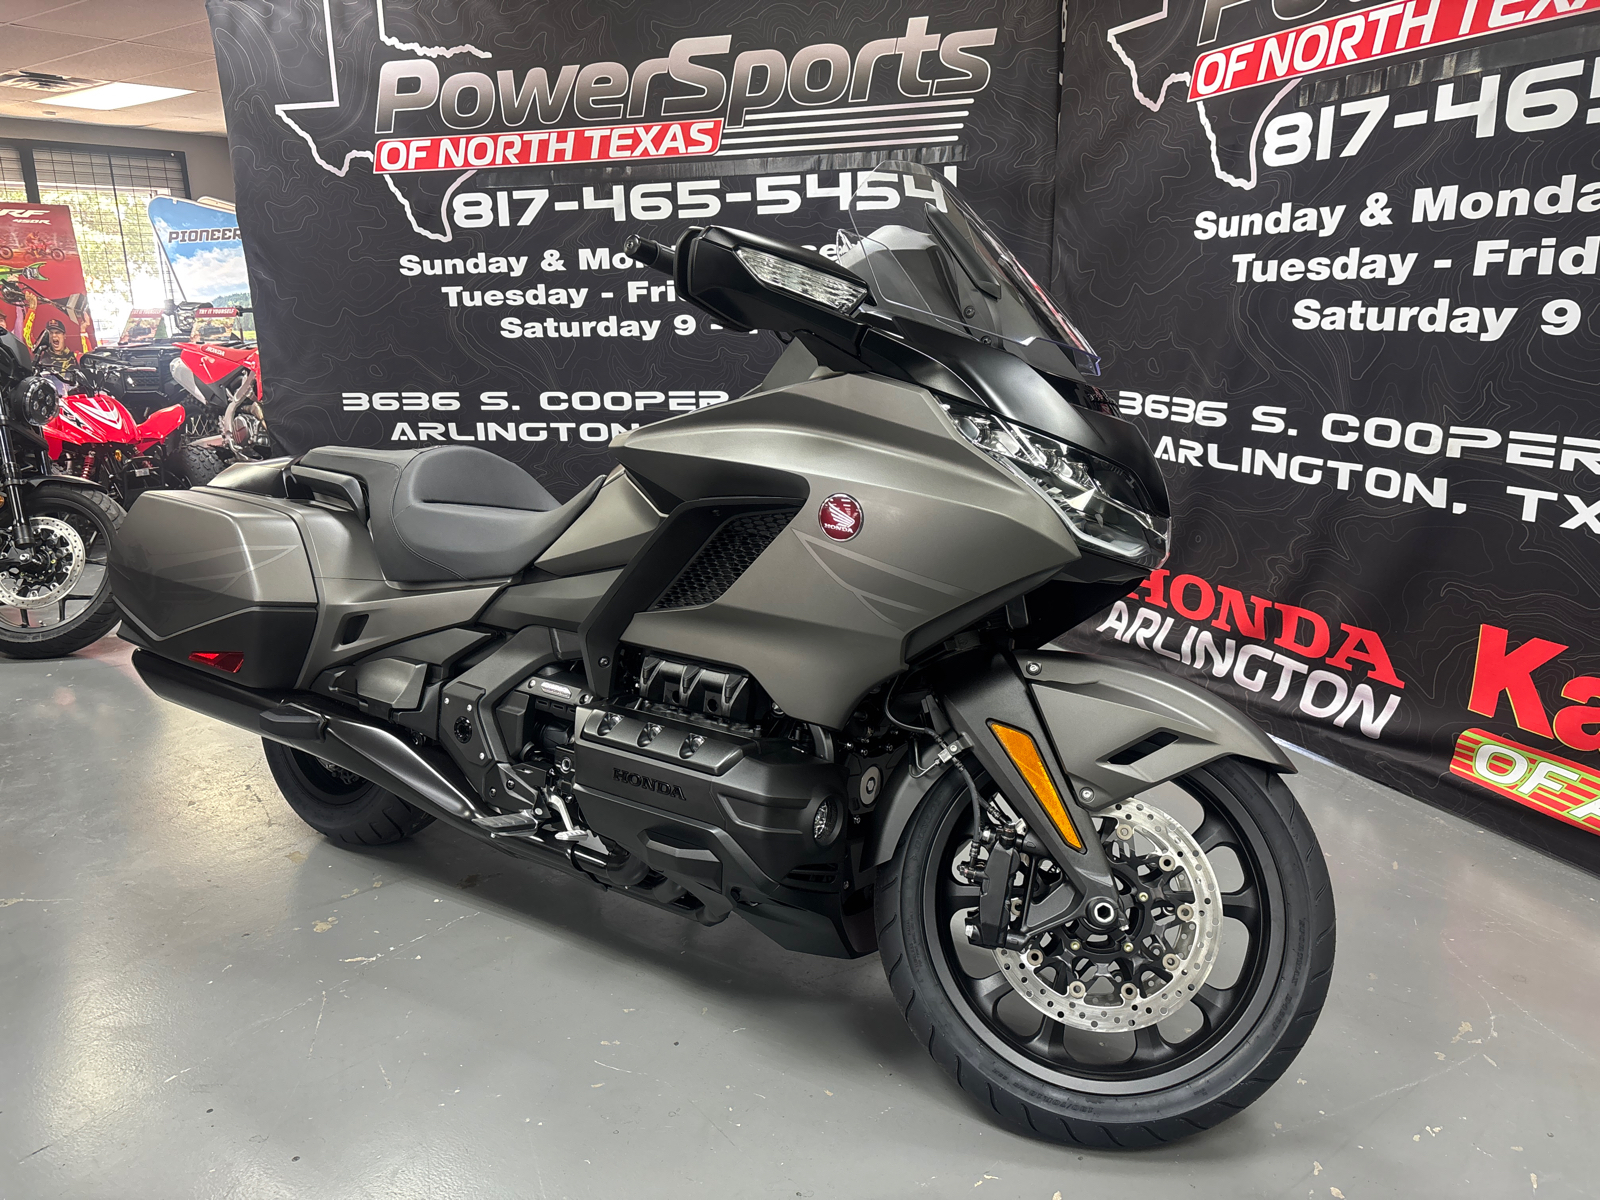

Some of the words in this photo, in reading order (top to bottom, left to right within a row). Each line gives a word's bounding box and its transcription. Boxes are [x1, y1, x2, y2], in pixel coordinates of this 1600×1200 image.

[1195, 43, 1256, 96] OF
[1257, 0, 1439, 81] NORTH
[374, 16, 998, 134] PowerSports
[1262, 57, 1600, 168] 817-46
[380, 140, 431, 170] OF
[437, 129, 584, 168] NORTH
[589, 120, 719, 159] TEXAS
[0, 209, 51, 218] RF
[452, 166, 958, 228] 817-465-5454
[1194, 203, 1346, 240] Sunday
[1359, 193, 1393, 227] &
[1411, 174, 1600, 223] Monda
[167, 227, 242, 244] PIONEER
[1232, 248, 1418, 286] Tuesday
[1473, 235, 1600, 276] Frid
[398, 251, 528, 277] Sunday
[541, 250, 567, 271] &
[442, 285, 589, 309] Tuesday
[627, 280, 677, 303] Fri
[1292, 298, 1518, 341] Saturday
[1540, 298, 1582, 336] 9
[499, 315, 661, 341] Saturday
[673, 314, 697, 336] 9
[341, 391, 461, 411] 3636
[480, 391, 521, 411] S.
[1118, 391, 1228, 427] 3636
[1251, 406, 1297, 436] S.
[1321, 413, 1600, 476] COOPER
[1155, 436, 1467, 514] ARLINGTON,
[823, 522, 854, 534] HONDA
[1126, 568, 1405, 690] HONDA
[1096, 600, 1402, 740] ARLINGTON
[1467, 623, 1600, 752] Ka
[613, 767, 687, 801] HONDA
[1475, 744, 1581, 796] OF
